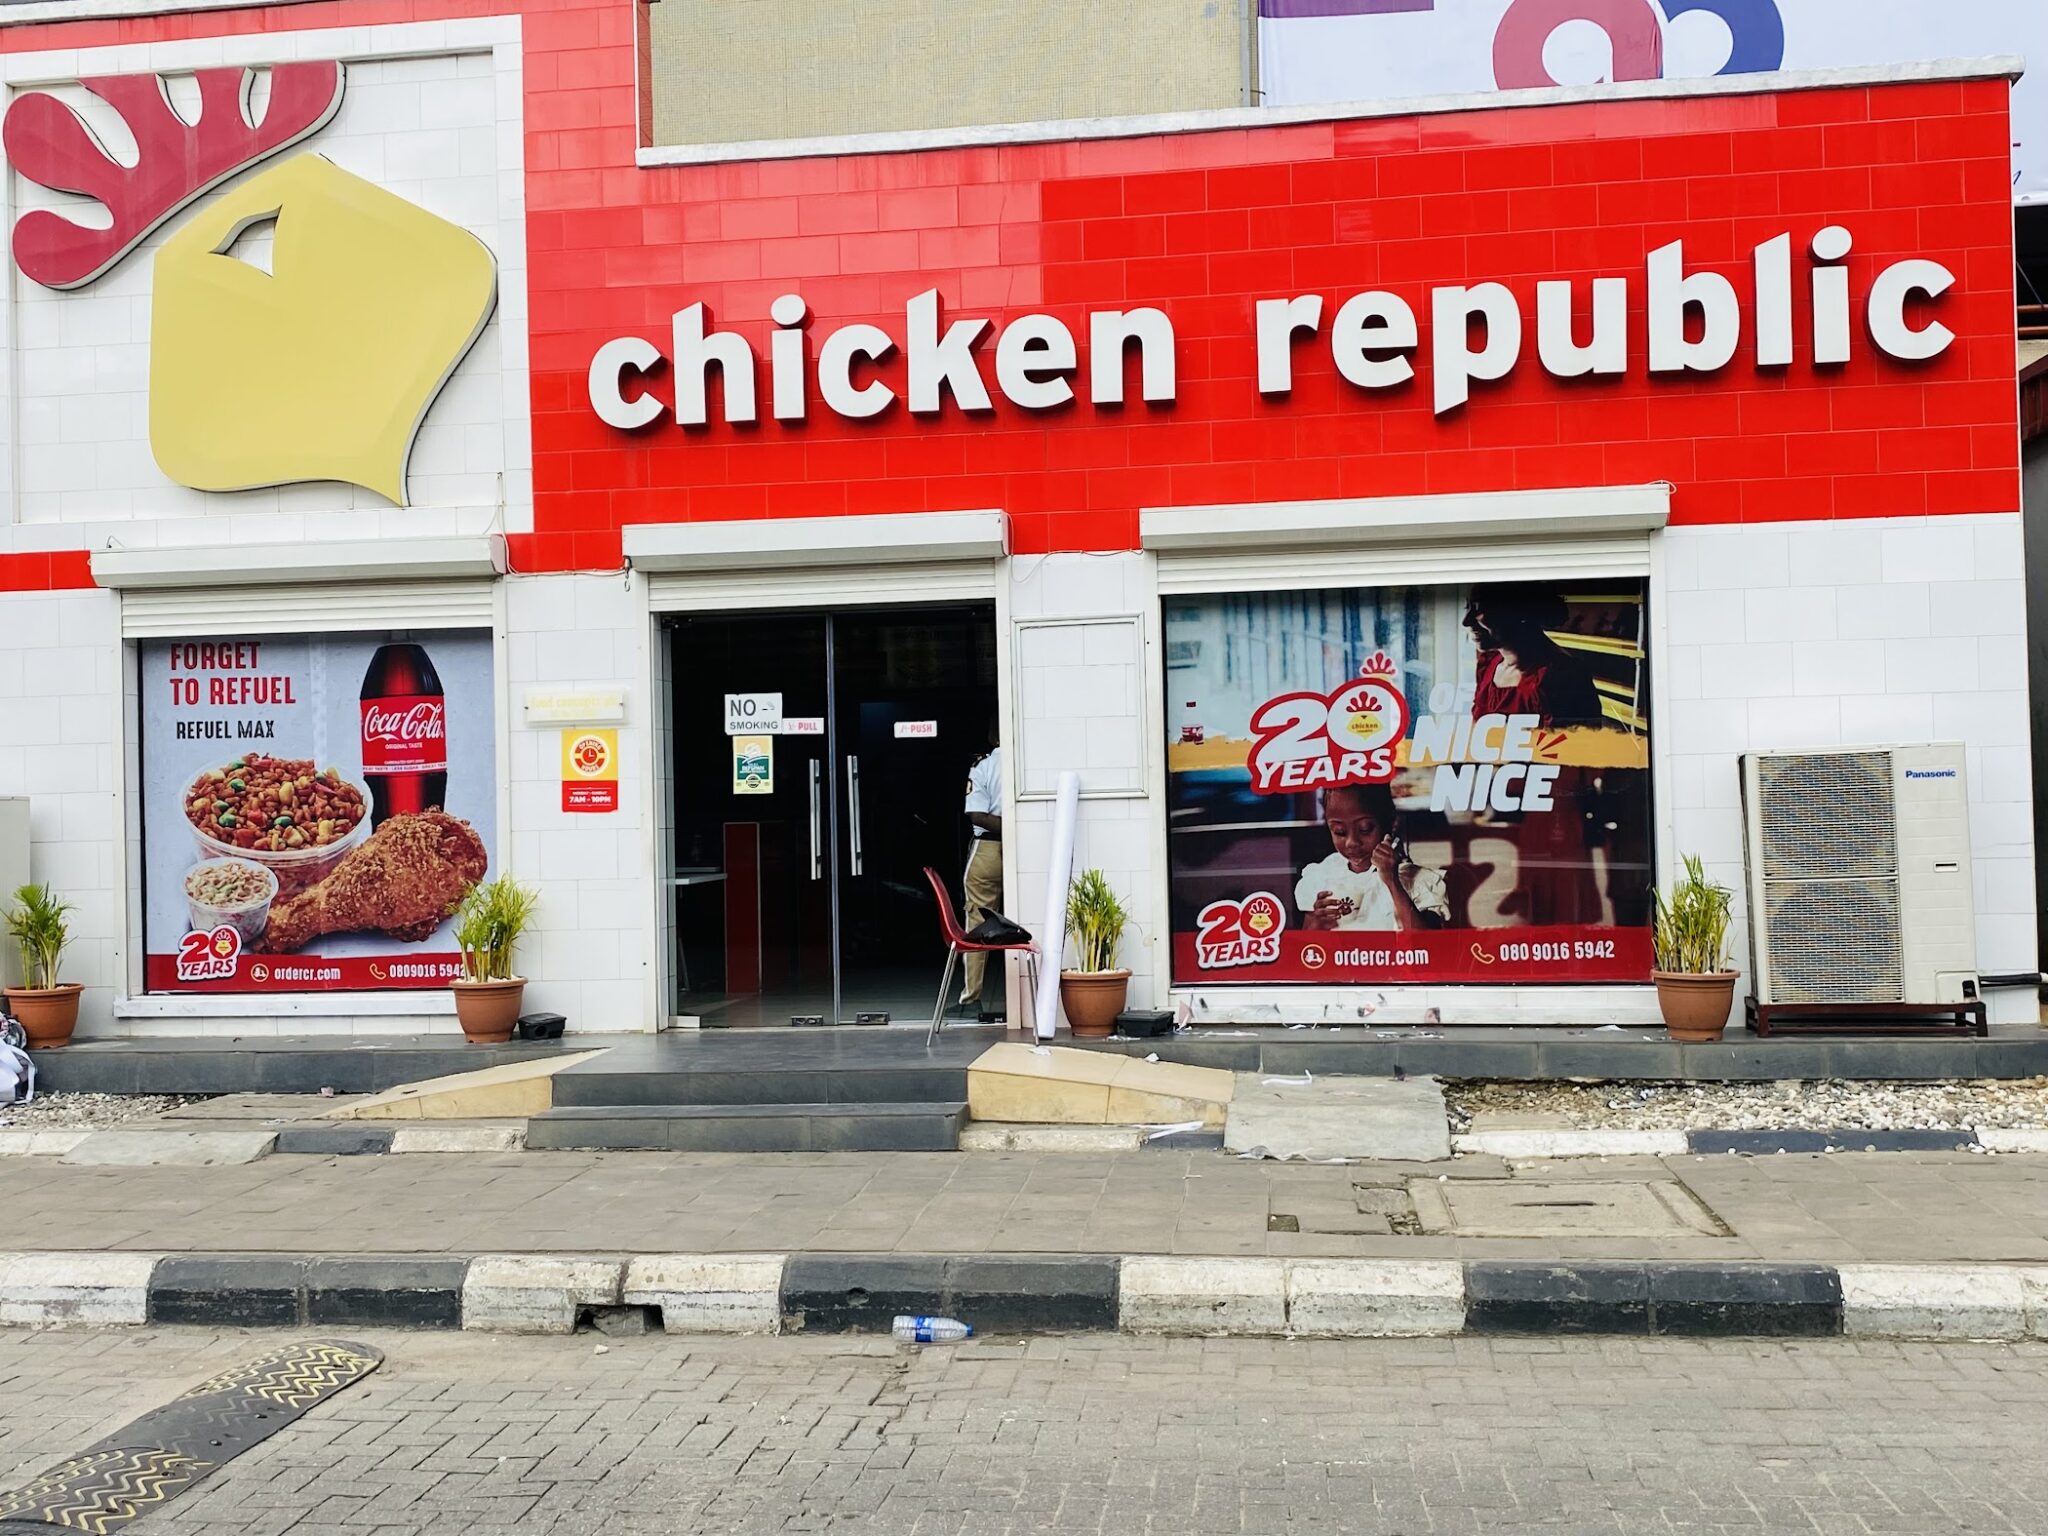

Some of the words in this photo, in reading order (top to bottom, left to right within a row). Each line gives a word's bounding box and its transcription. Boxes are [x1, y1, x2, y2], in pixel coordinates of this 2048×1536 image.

[588, 288, 1177, 428] chicken
[1255, 226, 1957, 416] republic
[171, 642, 261, 670] FORGET
[169, 678, 199, 705] TO
[210, 677, 296, 704] REFUEL
[730, 699, 756, 717] NO
[176, 721, 231, 739] REFUEL
[238, 720, 274, 738] MAX
[364, 703, 442, 742] Coca-Cola
[730, 721, 778, 730] SMOKING
[798, 722, 817, 731] PULL
[911, 724, 932, 734] PUSH
[1257, 684, 1402, 762] 20
[1409, 713, 1540, 762] NICE
[1255, 747, 1392, 788] YEARS
[1906, 769, 1956, 778] Panasonic
[1430, 763, 1560, 812] NICE
[1201, 897, 1281, 945] 20
[181, 928, 237, 963] 20
[1202, 938, 1274, 963] YEARS
[1334, 948, 1429, 966] ordercr.com
[1500, 943, 1529, 961] 080
[1532, 942, 1569, 961] 9016
[1574, 940, 1615, 959] 5942
[181, 959, 233, 976] YEARS
[274, 967, 341, 980] ordercr.com
